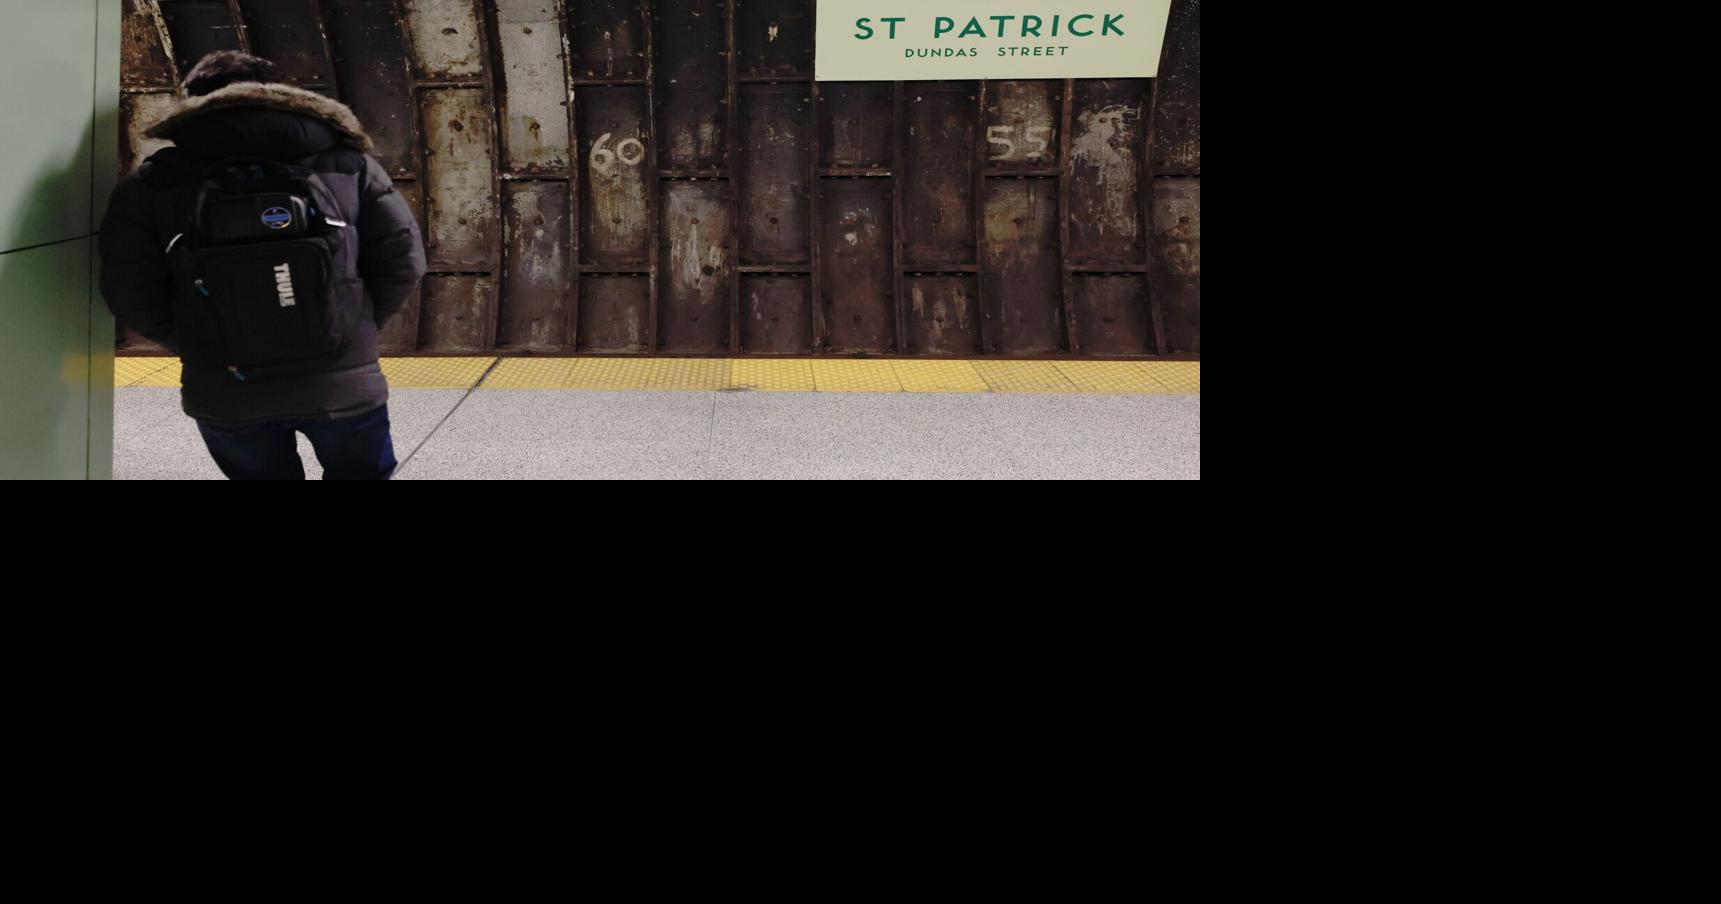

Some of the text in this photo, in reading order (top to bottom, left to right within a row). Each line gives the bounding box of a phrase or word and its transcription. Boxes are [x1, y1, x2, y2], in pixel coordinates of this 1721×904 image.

[854, 13, 1126, 40] ST PATRICK
[904, 46, 1069, 58] DUNDAS STREET
[589, 132, 645, 173] 60
[986, 125, 1051, 161] 55
[273, 262, 296, 307] THULE
